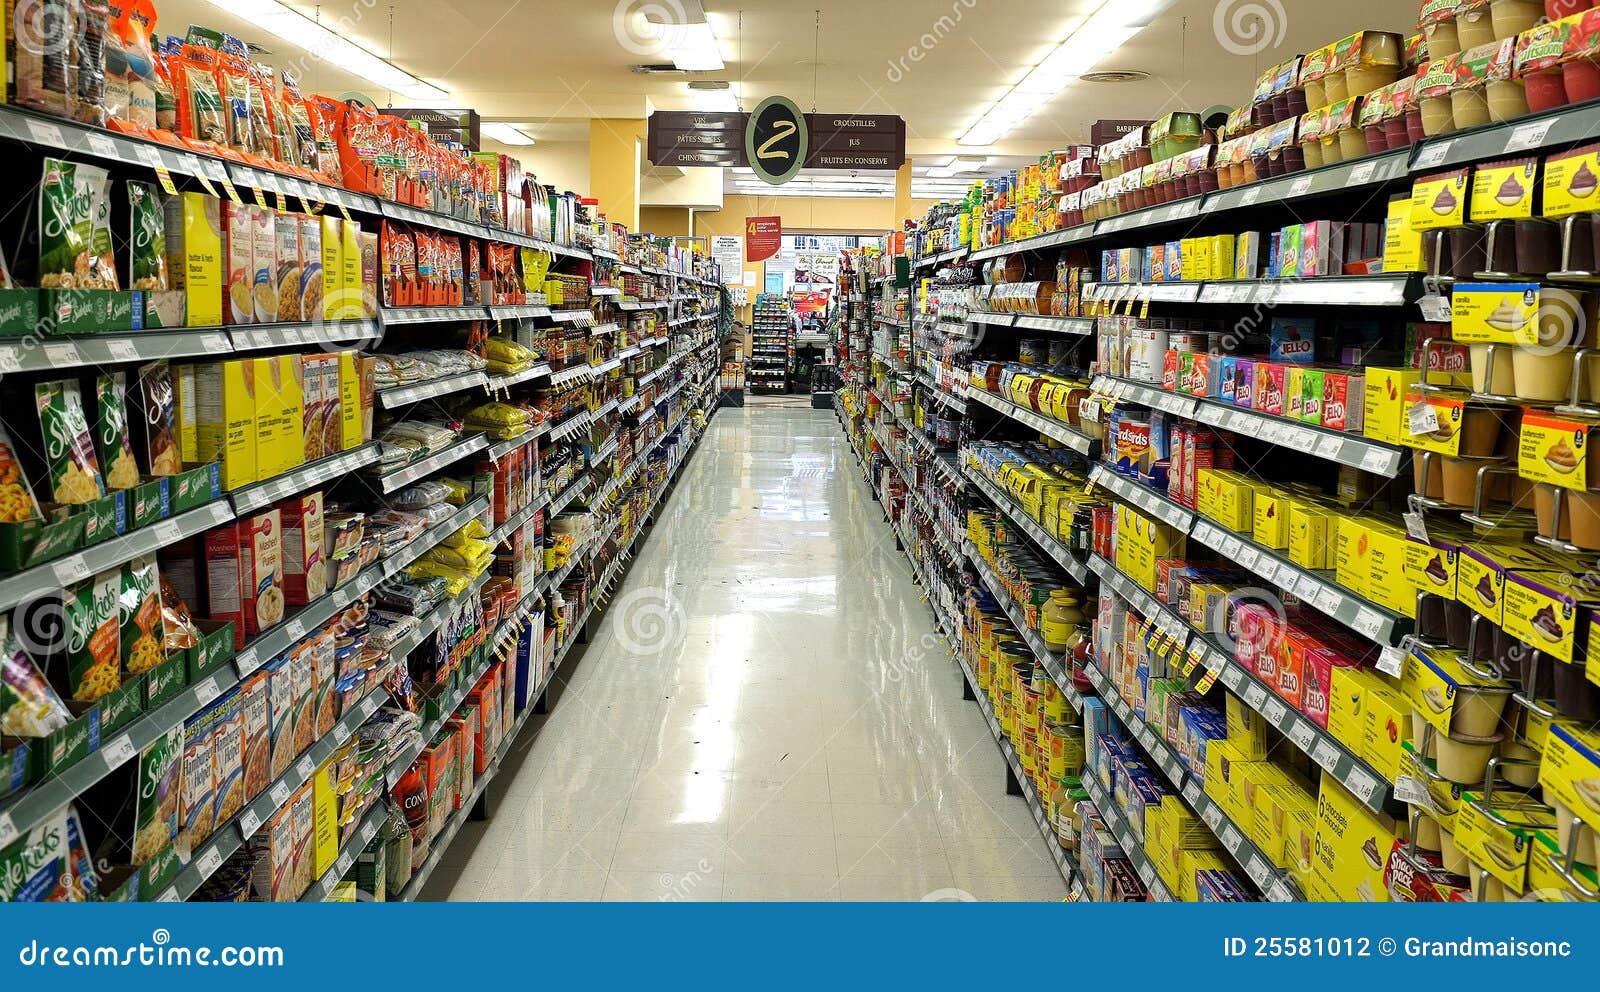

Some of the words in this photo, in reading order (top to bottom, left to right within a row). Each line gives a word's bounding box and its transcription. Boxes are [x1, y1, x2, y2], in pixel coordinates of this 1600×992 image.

[411, 114, 448, 122] MARINADES
[833, 119, 876, 128] CROUSTILLES
[677, 134, 697, 143] PÂTES
[757, 120, 796, 159] 2
[849, 138, 860, 147] JUS
[820, 156, 844, 165] FRUITS
[844, 156, 853, 165] EN
[854, 157, 888, 165] CONSERVE
[747, 222, 757, 235] 4
[1281, 341, 1311, 355] JELL-O
[1319, 793, 1326, 818] 6
[1325, 800, 1348, 830] chocolate
[1324, 814, 1344, 839] chocolat
[1315, 831, 1321, 856] 6
[1390, 851, 1415, 878] Snack
